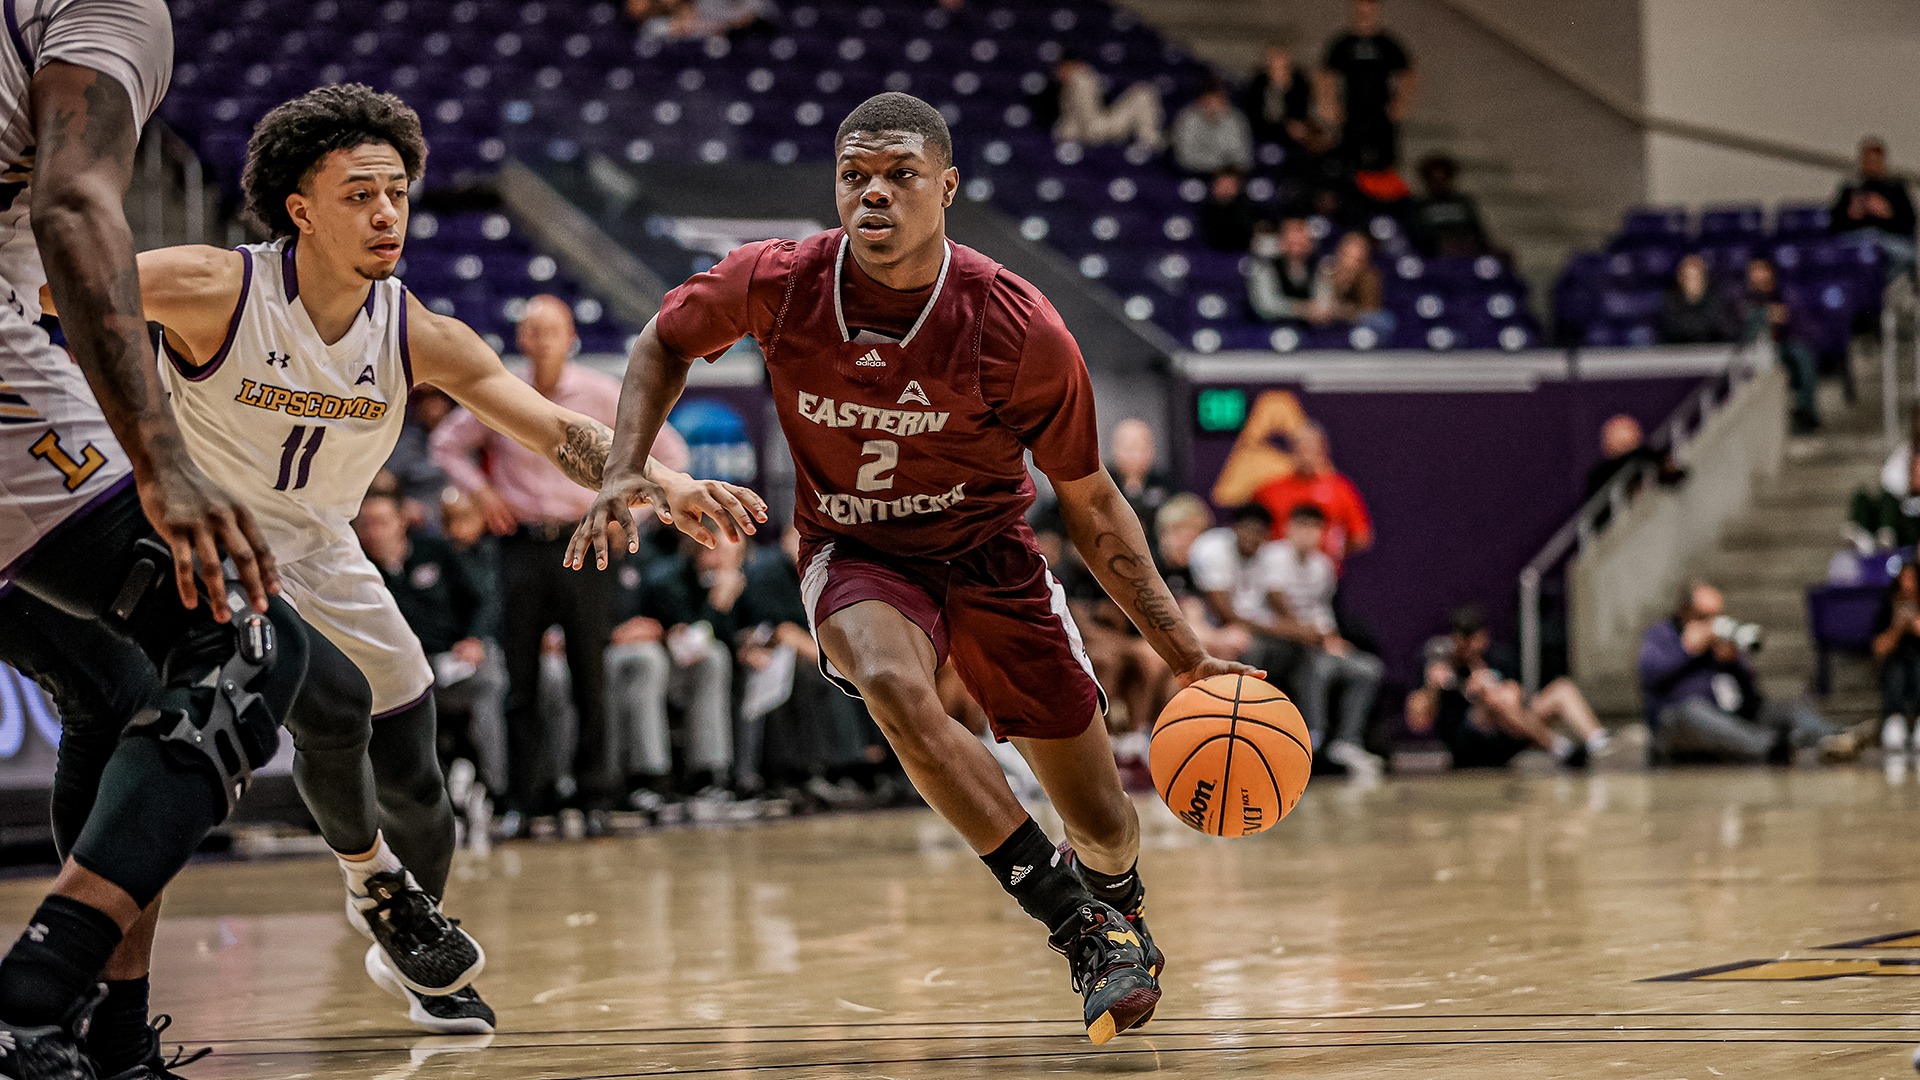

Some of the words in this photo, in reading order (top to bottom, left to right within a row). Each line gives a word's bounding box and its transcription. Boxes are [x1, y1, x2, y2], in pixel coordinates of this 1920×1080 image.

[235, 378, 387, 420] LIPSCOMB
[798, 390, 950, 437] EASTERN
[28, 428, 109, 493] L
[273, 425, 326, 491] 11
[856, 439, 899, 492] 2
[814, 482, 967, 525] KENTUCKY
[1180, 780, 1216, 831] lson
[1010, 864, 1034, 886] adidas
